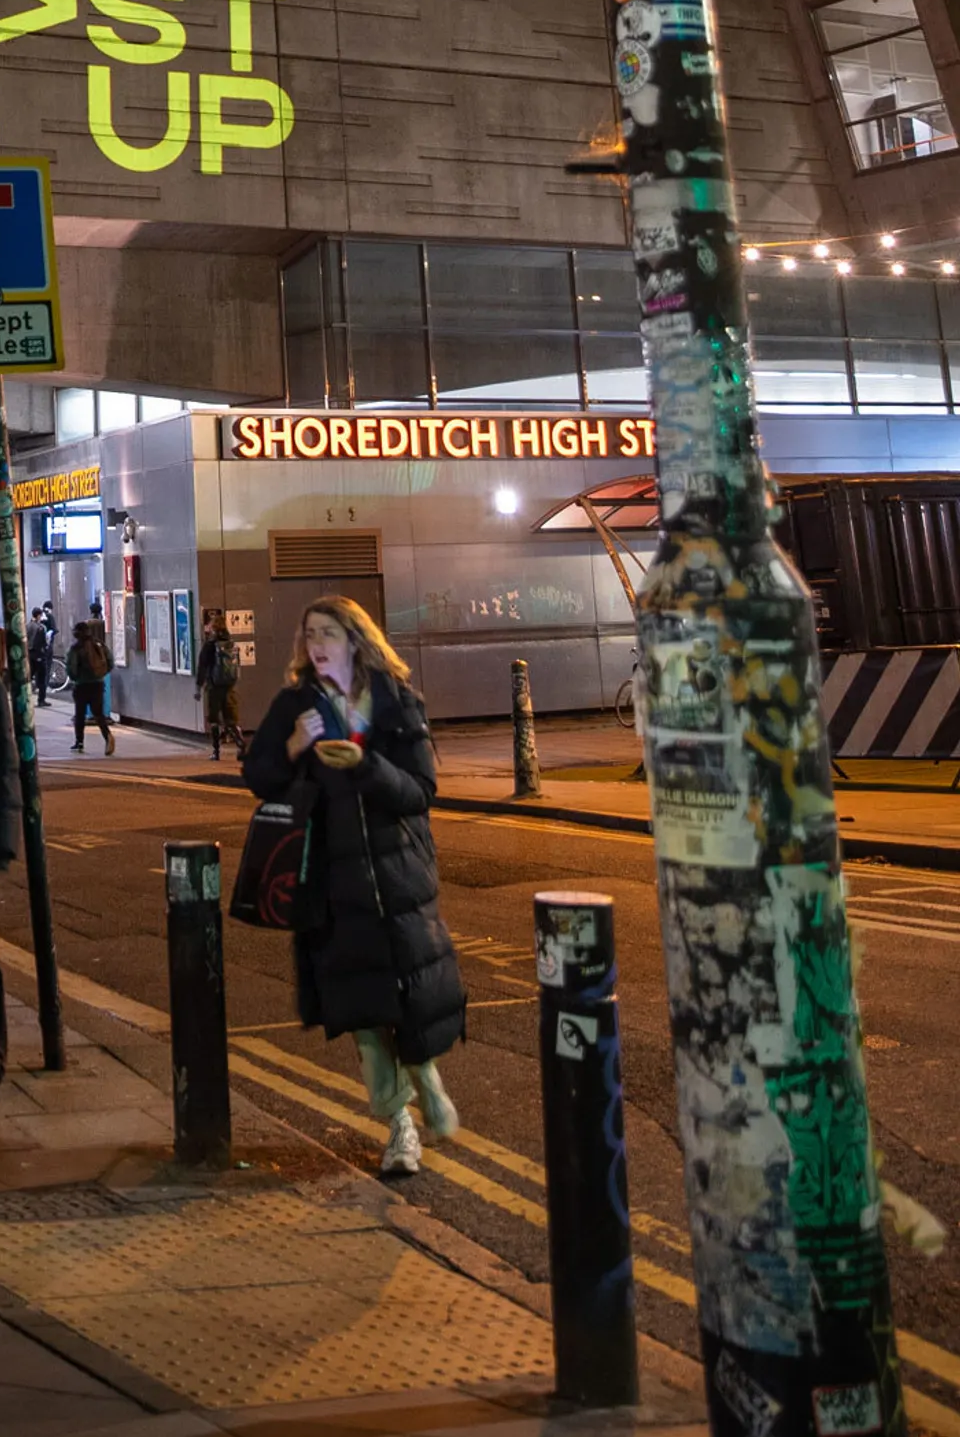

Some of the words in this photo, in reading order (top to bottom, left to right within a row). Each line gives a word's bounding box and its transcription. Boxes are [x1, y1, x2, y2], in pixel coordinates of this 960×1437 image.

[88, 65, 294, 175] UP
[239, 417, 496, 458] SHOREDITCH
[514, 419, 608, 458] HIGH
[12, 477, 50, 510] HOREDITCH
[50, 473, 70, 504] HIGH
[71, 466, 101, 500] STREET
